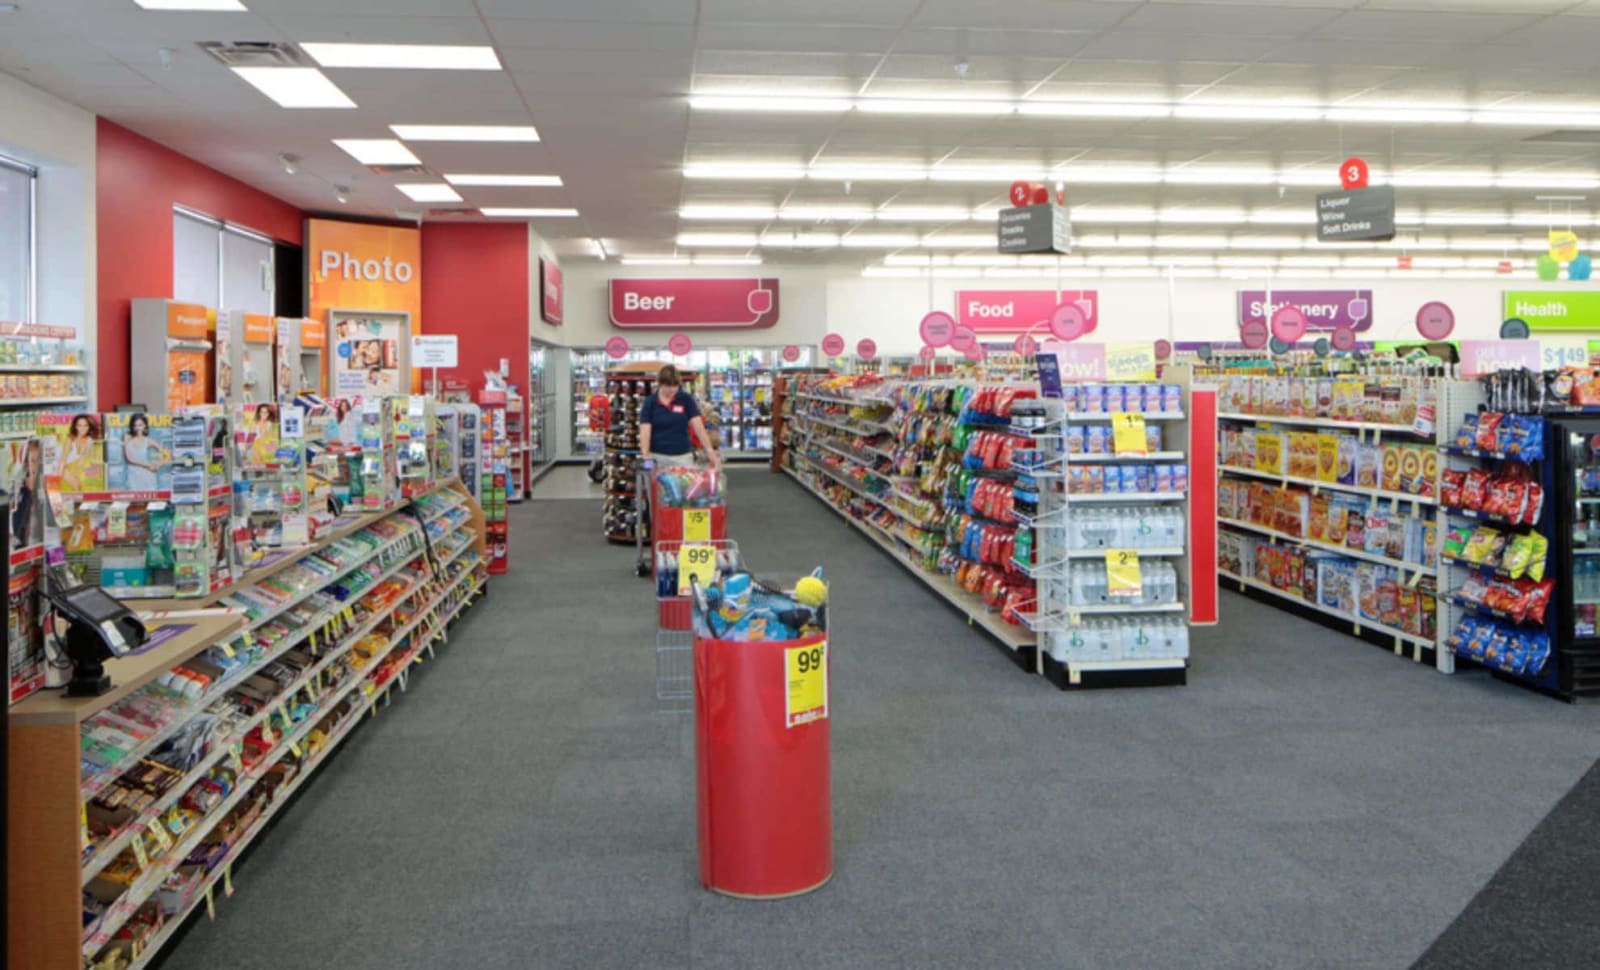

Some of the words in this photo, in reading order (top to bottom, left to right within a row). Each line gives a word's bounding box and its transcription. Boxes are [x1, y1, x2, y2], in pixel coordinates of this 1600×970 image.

[1347, 165, 1360, 182] 3
[1015, 186, 1025, 201] 2
[1320, 197, 1350, 208] Liquor
[1321, 211, 1345, 221] Wine
[1322, 224, 1341, 235] Soft
[1342, 221, 1371, 233] Drinks
[319, 250, 413, 284] Photo
[623, 292, 676, 312] Beer
[968, 301, 1014, 318] Food
[1515, 302, 1568, 317] Health
